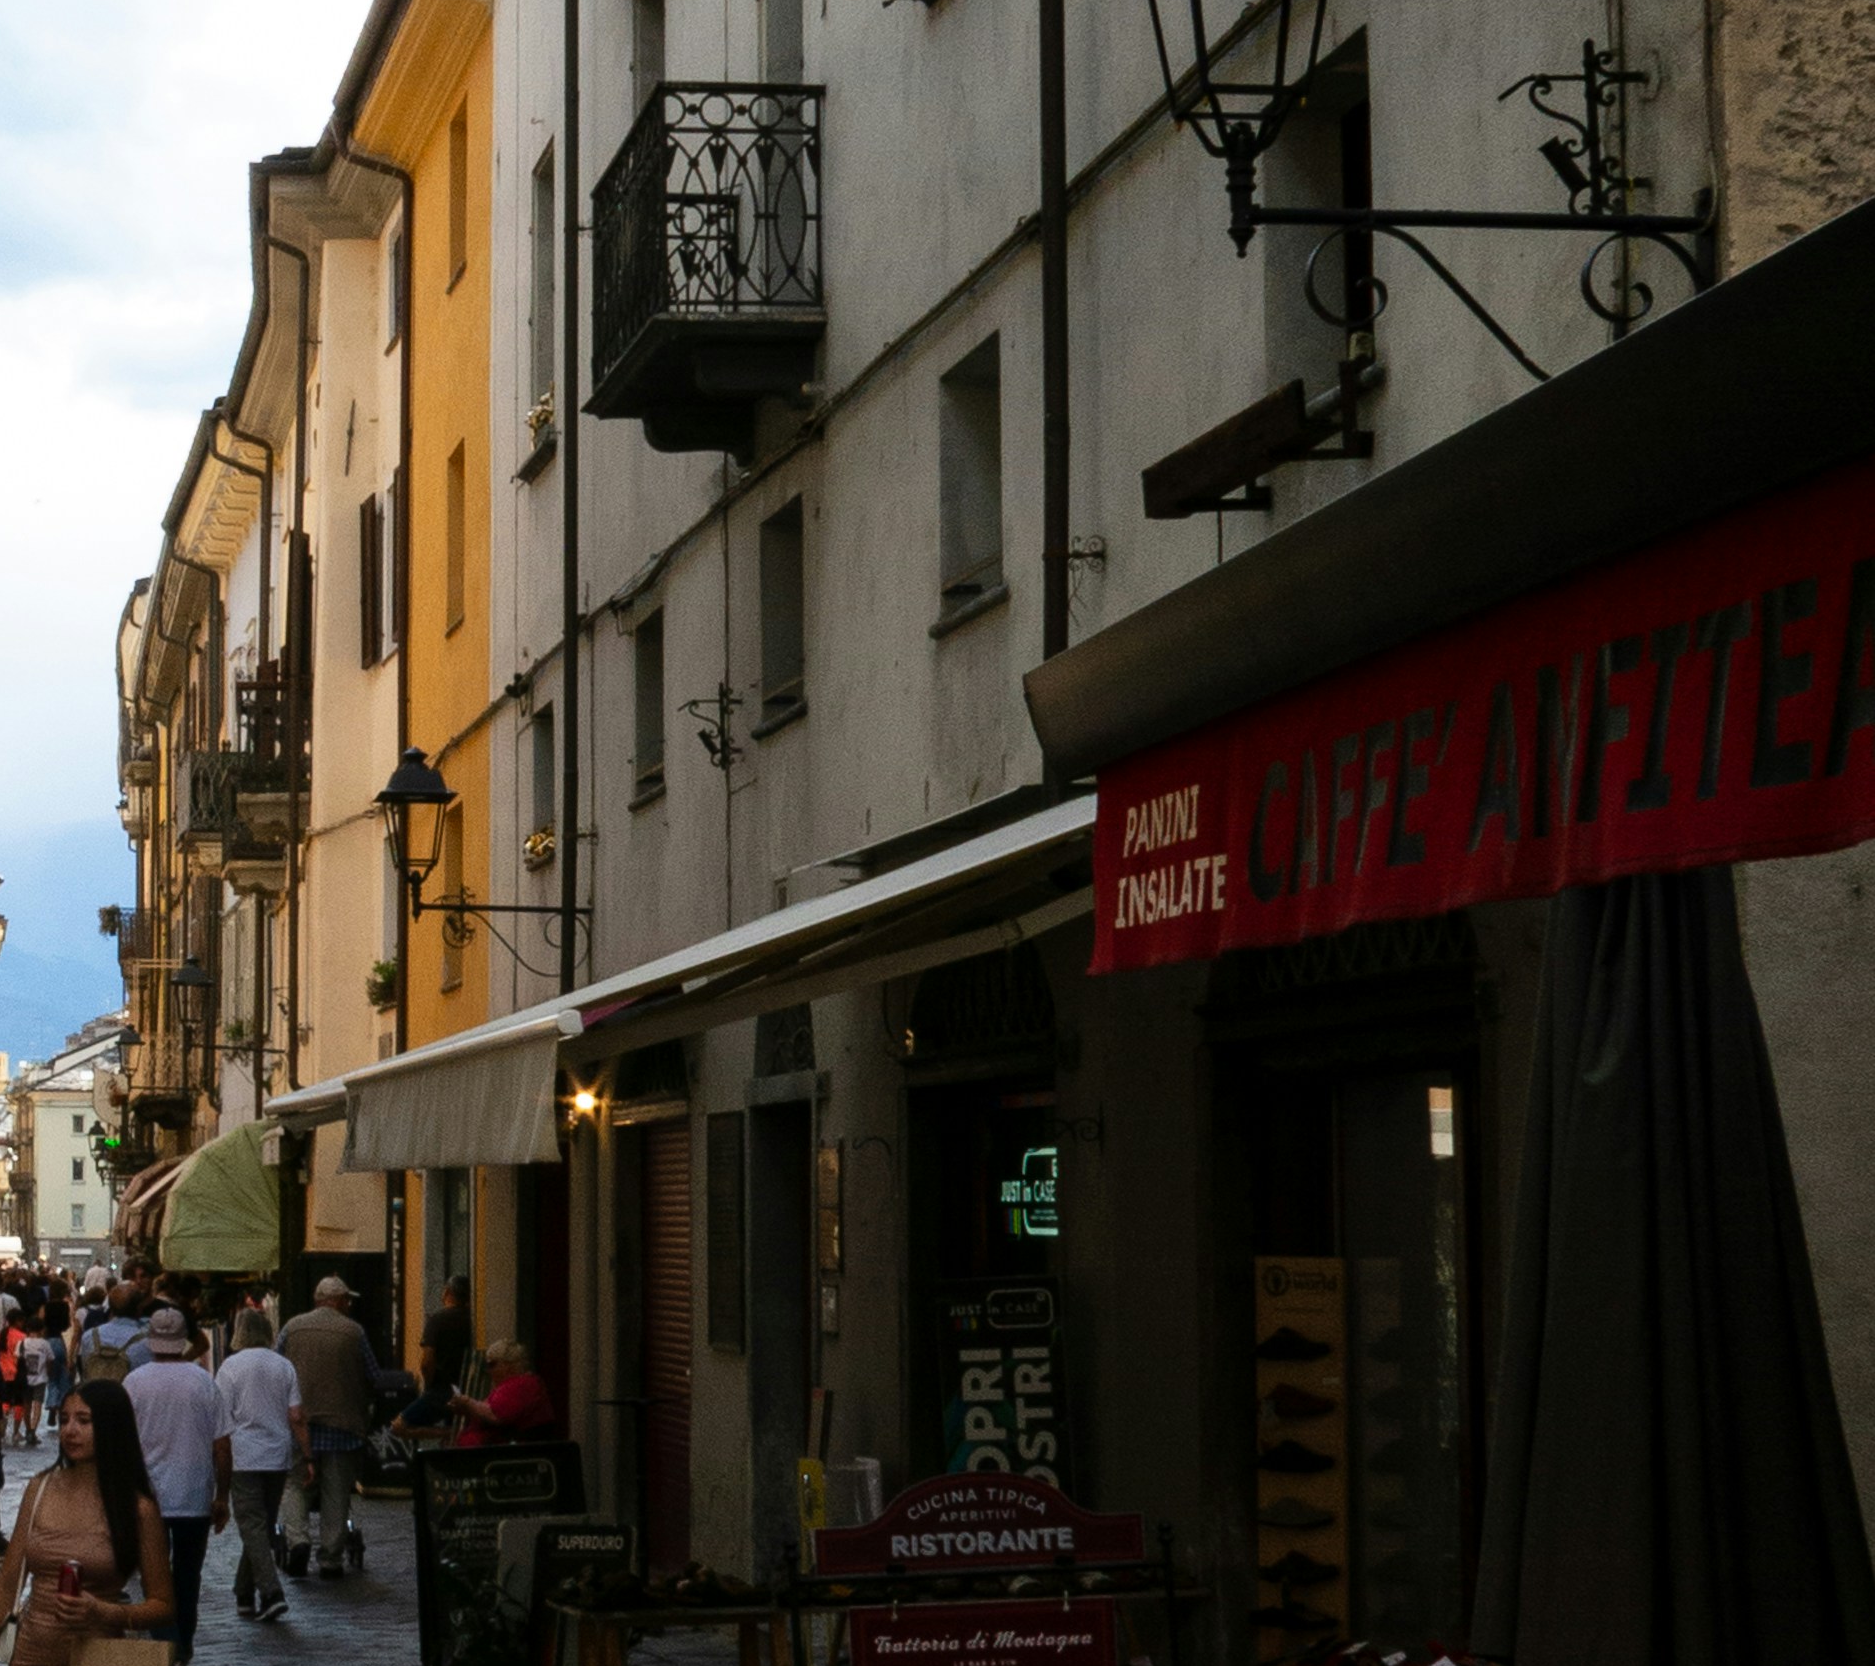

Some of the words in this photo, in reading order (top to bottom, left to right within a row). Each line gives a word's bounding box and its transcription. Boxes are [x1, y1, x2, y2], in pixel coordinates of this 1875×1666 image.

[1247, 700, 1458, 903] CAFFE'
[1122, 784, 1201, 859] PANINI
[1114, 853, 1227, 930] INSALATE
[948, 1303, 982, 1316] JUST
[1005, 1300, 1040, 1315] CASE
[906, 1487, 978, 1522] CUCINA
[985, 1485, 1048, 1517] TIPICA
[938, 1509, 1017, 1524] APERITIVI
[557, 1534, 625, 1551] SUPERDURO
[890, 1526, 1075, 1559] RISTORANTE
[873, 1631, 961, 1656] Trattoria
[966, 1630, 990, 1652] di
[991, 1629, 1095, 1654] Montagna
